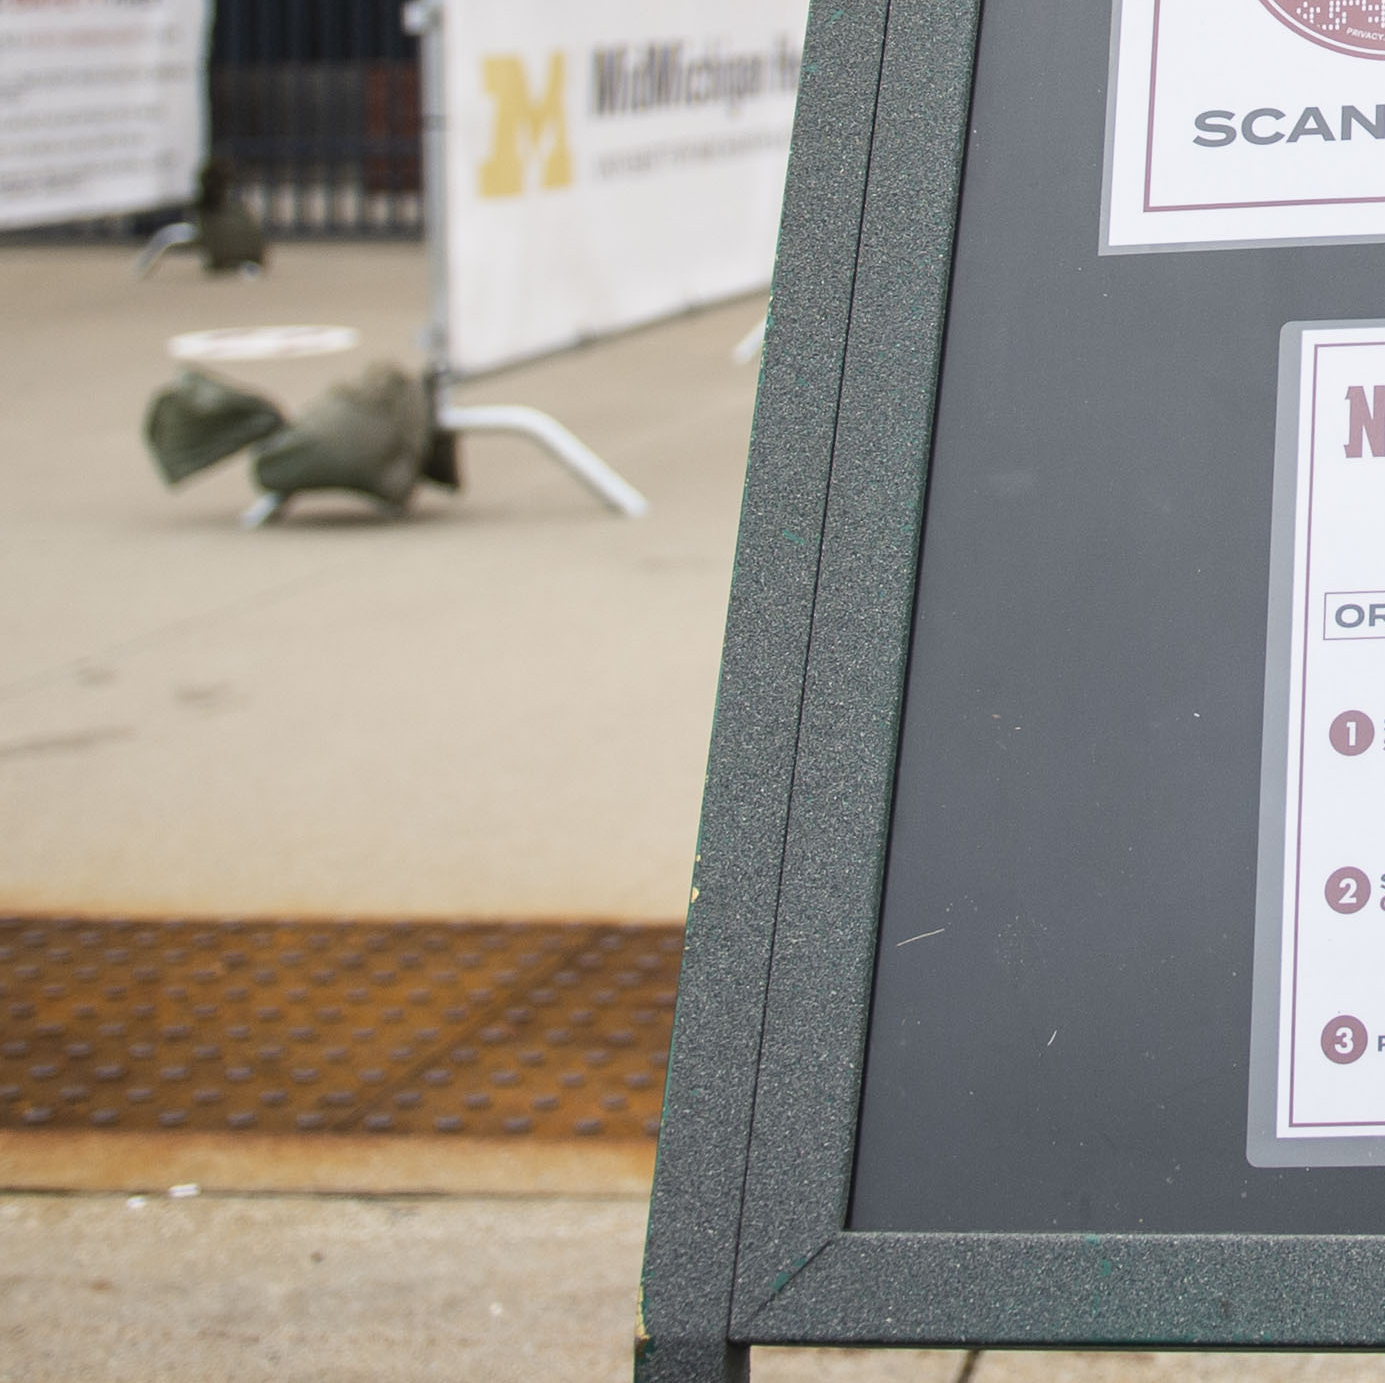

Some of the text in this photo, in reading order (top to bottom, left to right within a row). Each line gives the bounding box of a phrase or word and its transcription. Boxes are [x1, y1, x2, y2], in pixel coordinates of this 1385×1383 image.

[1346, 721, 1357, 746] 1
[1338, 878, 1358, 904] 2
[1334, 1027, 1355, 1054] 3
